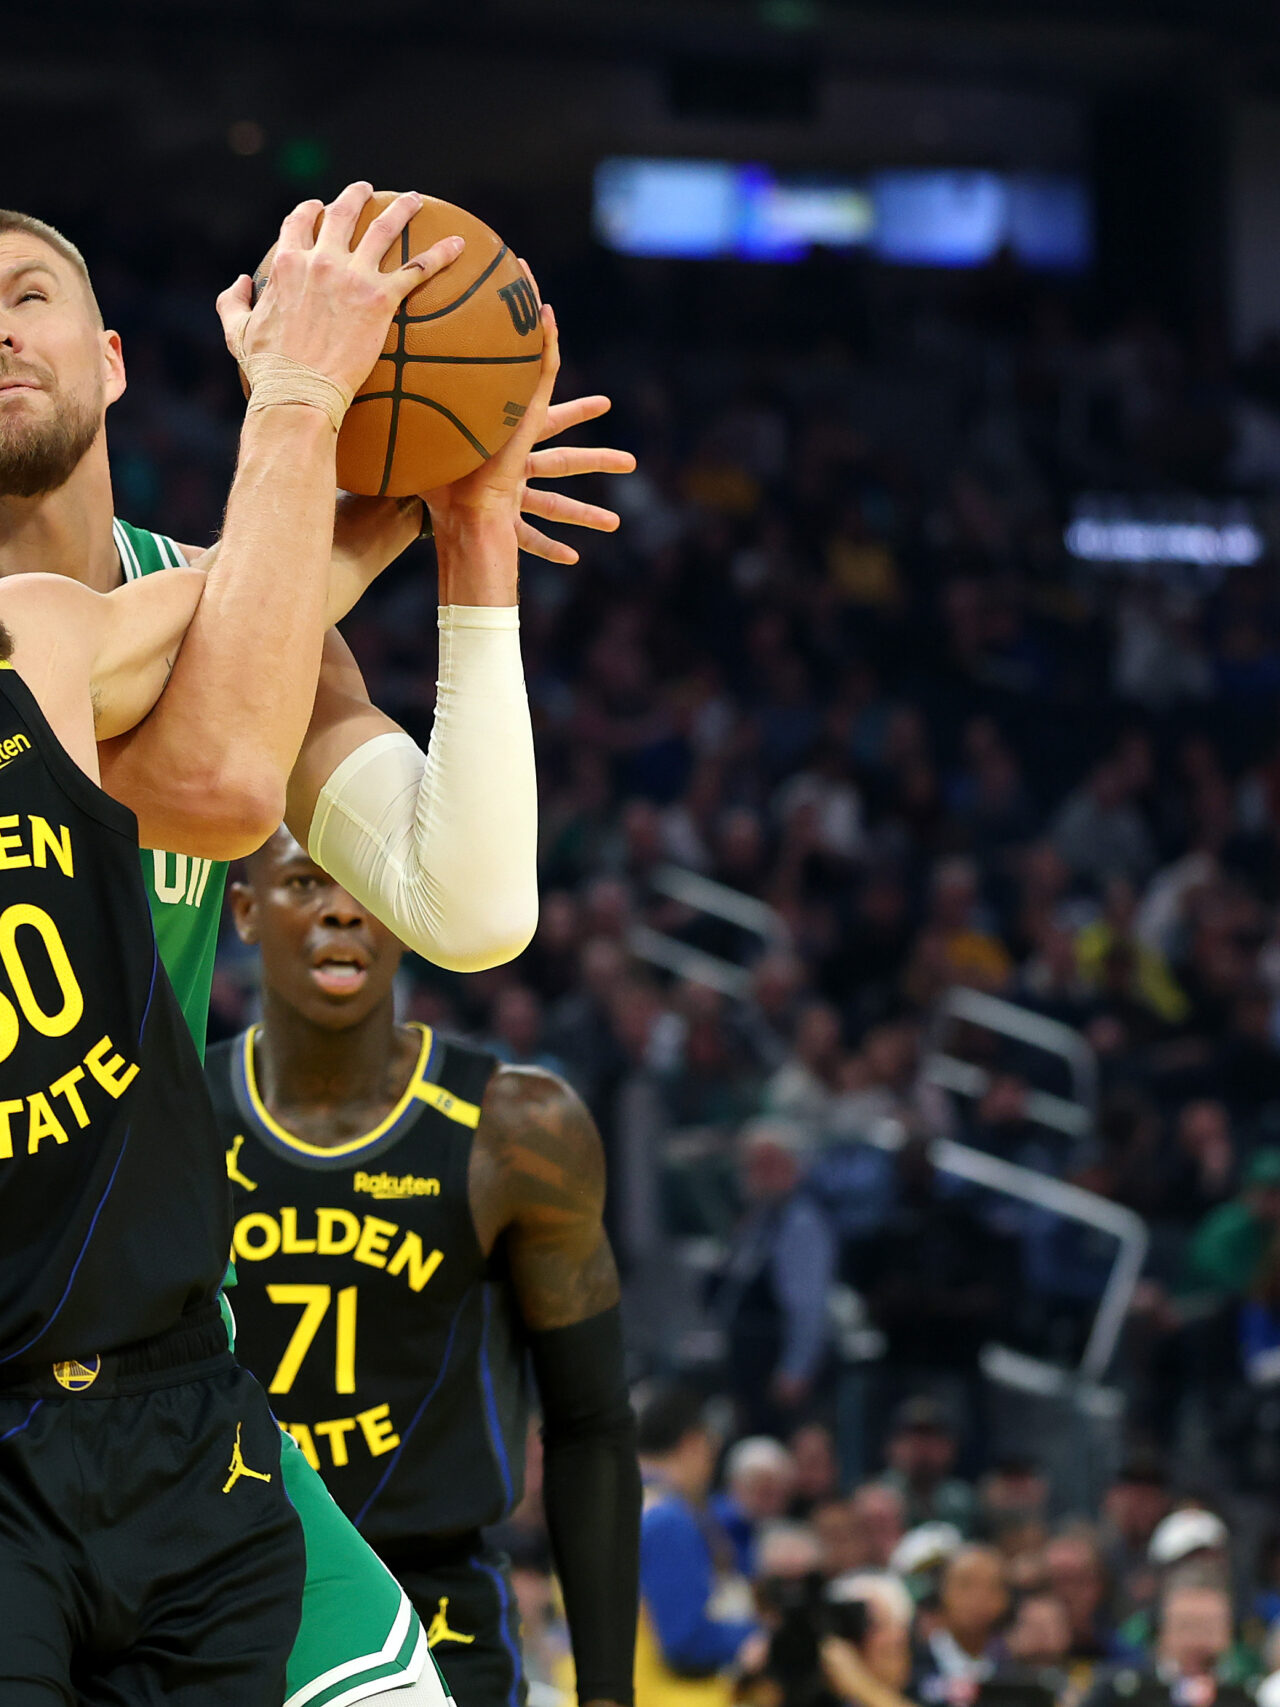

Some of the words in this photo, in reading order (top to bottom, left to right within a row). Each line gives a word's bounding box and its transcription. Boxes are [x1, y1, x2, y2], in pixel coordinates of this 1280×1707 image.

[353, 1171, 441, 1199] Rakuten
[232, 1206, 444, 1292] OLDEN
[265, 1284, 358, 1394] 71
[278, 1403, 401, 1471] ATE
